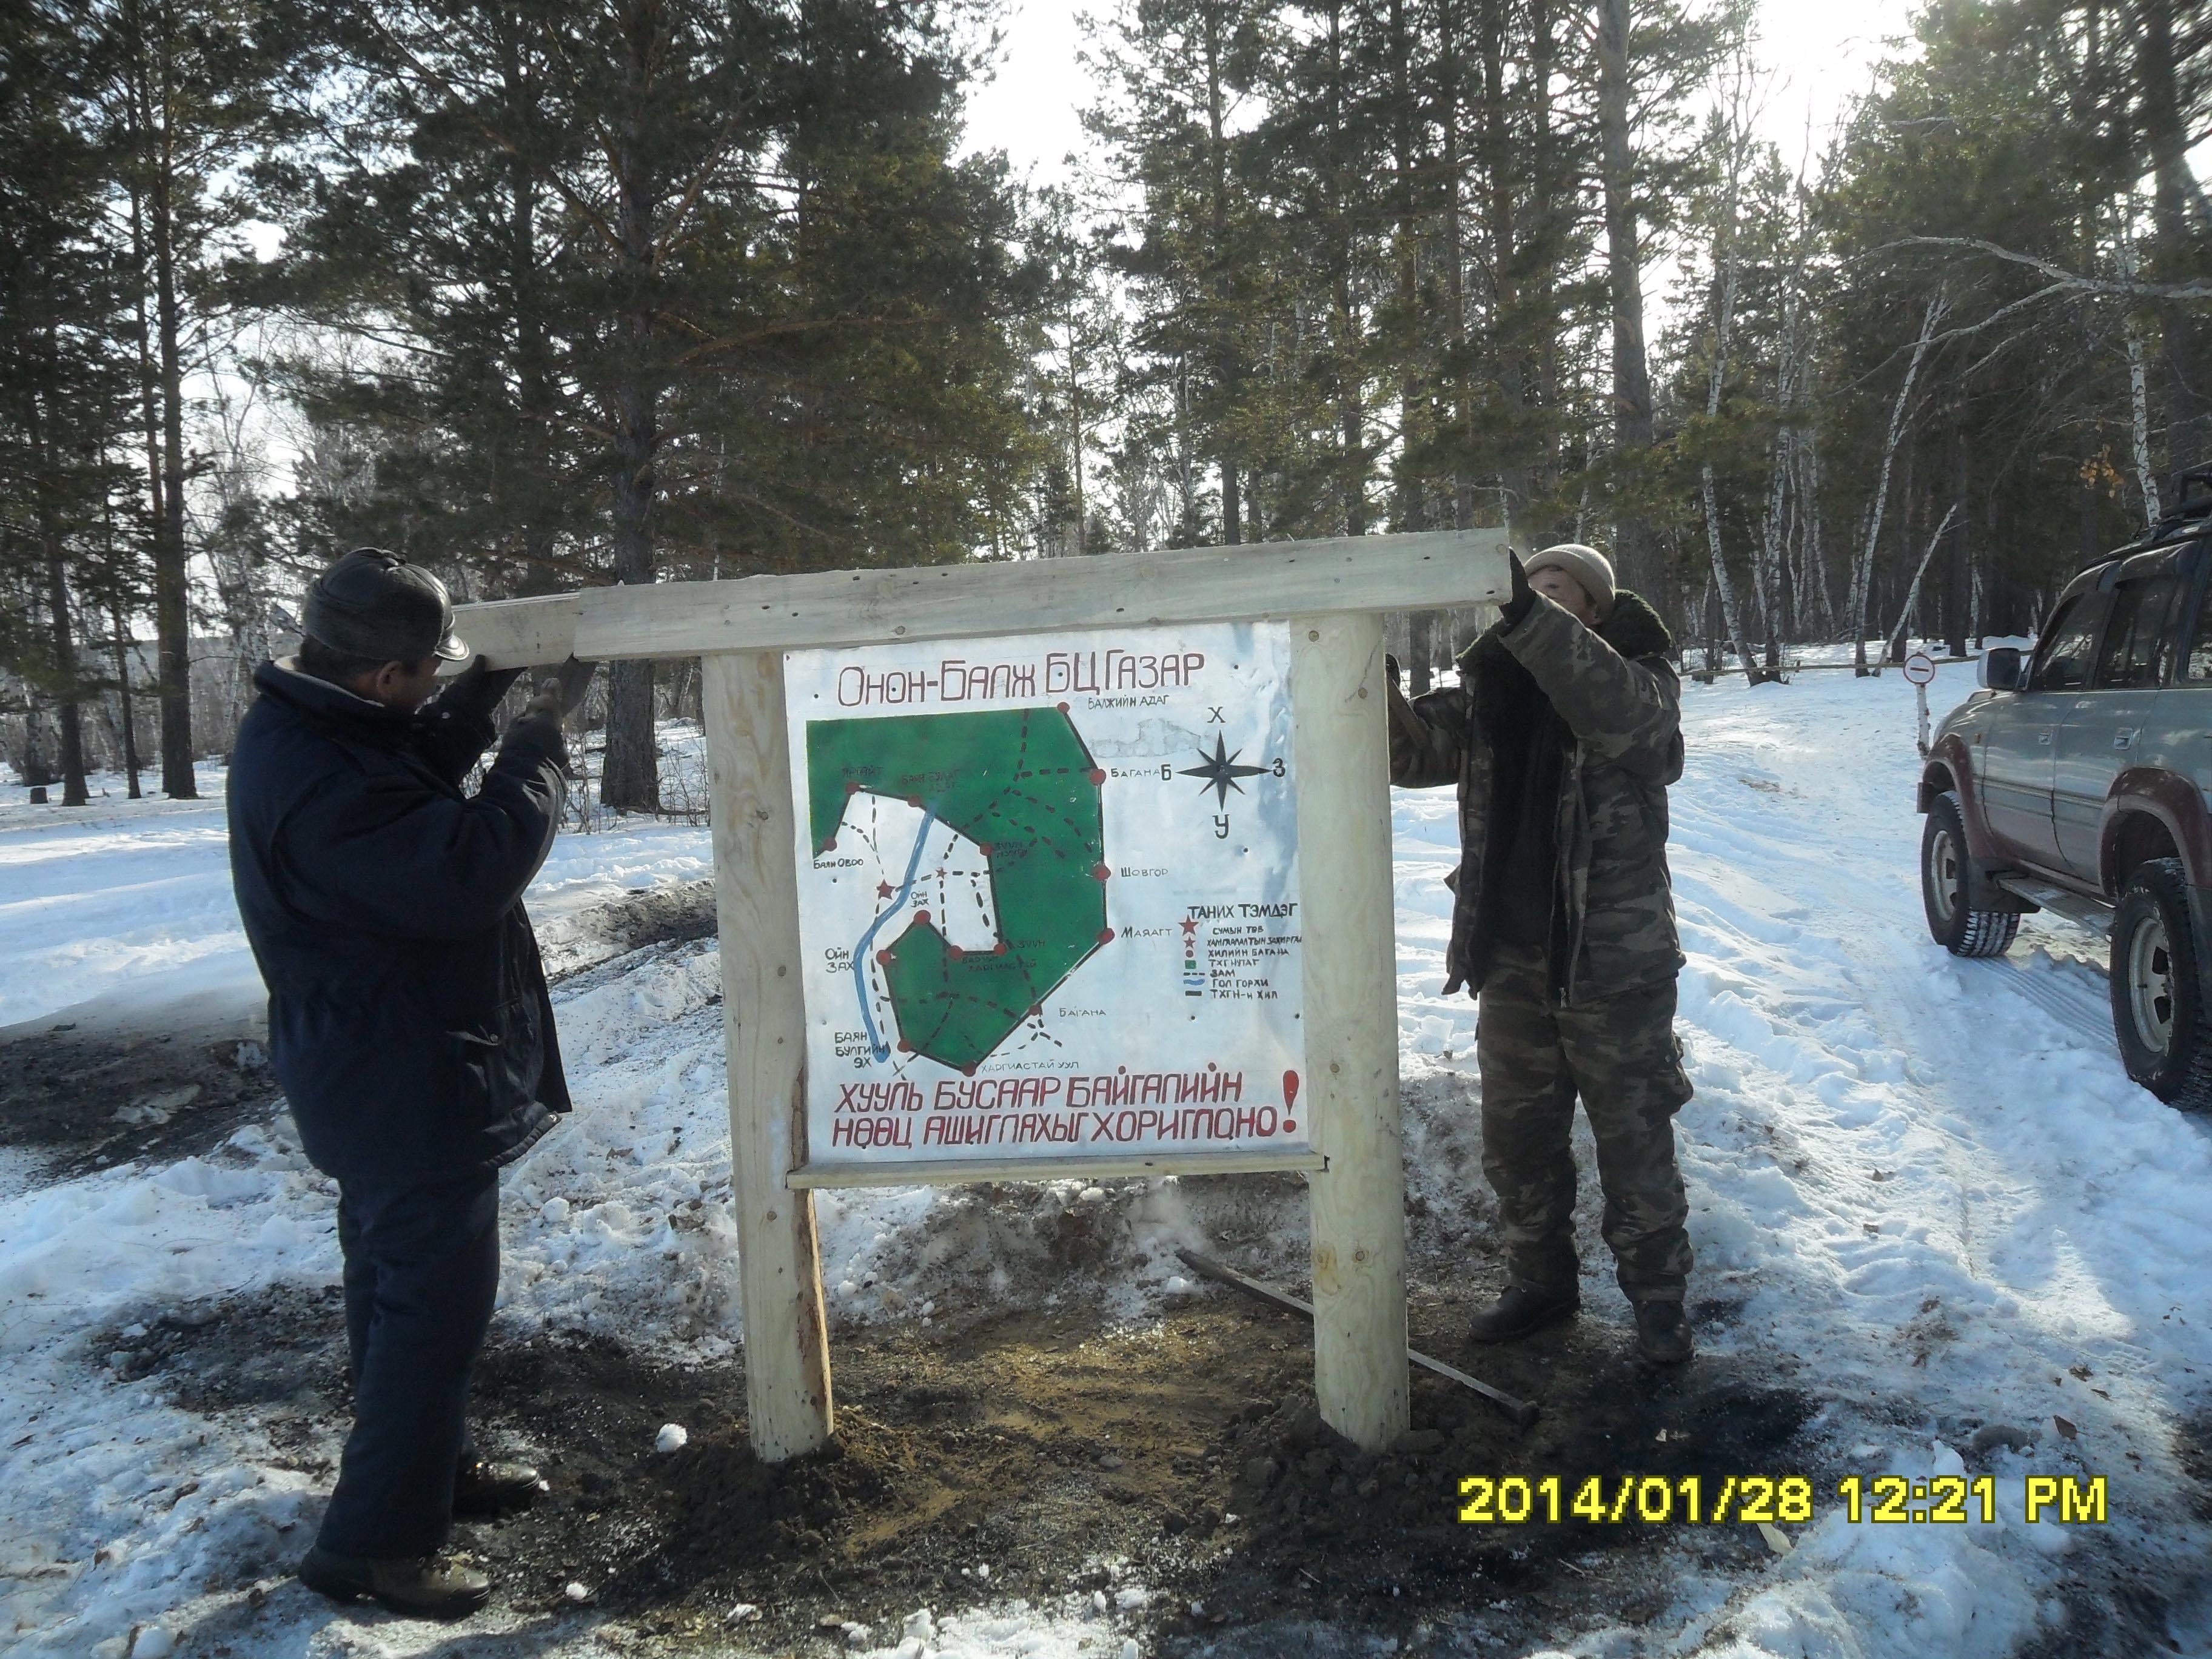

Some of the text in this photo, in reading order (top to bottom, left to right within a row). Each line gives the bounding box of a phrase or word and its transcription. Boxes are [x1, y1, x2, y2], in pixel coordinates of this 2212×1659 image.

[1088, 694, 1169, 709] БАЛЖИЙН АДАГ
[1161, 764, 1171, 781] Б
[1212, 814, 1230, 839] У
[1187, 903, 1298, 919] ТАНИХ ТЭМДЭГ
[1208, 948, 1248, 958] ХИЛИЙН
[1210, 969, 1235, 977] ЗАМ
[1213, 979, 1269, 988] ГОЛ ГОРХИ
[1257, 991, 1278, 1000] ХИЛ
[834, 1031, 867, 1044] БАЯН
[854, 1057, 872, 1068] ЭХ
[981, 1059, 1054, 1074] ХАРГИАСТАЙ
[834, 1062, 1242, 1113] ХУУЛЬ БУСААР БАЙГАЛИЙН
[833, 1116, 911, 1149] НӨӨЦ
[923, 1112, 1088, 1145] АШИГЛАХЫГ
